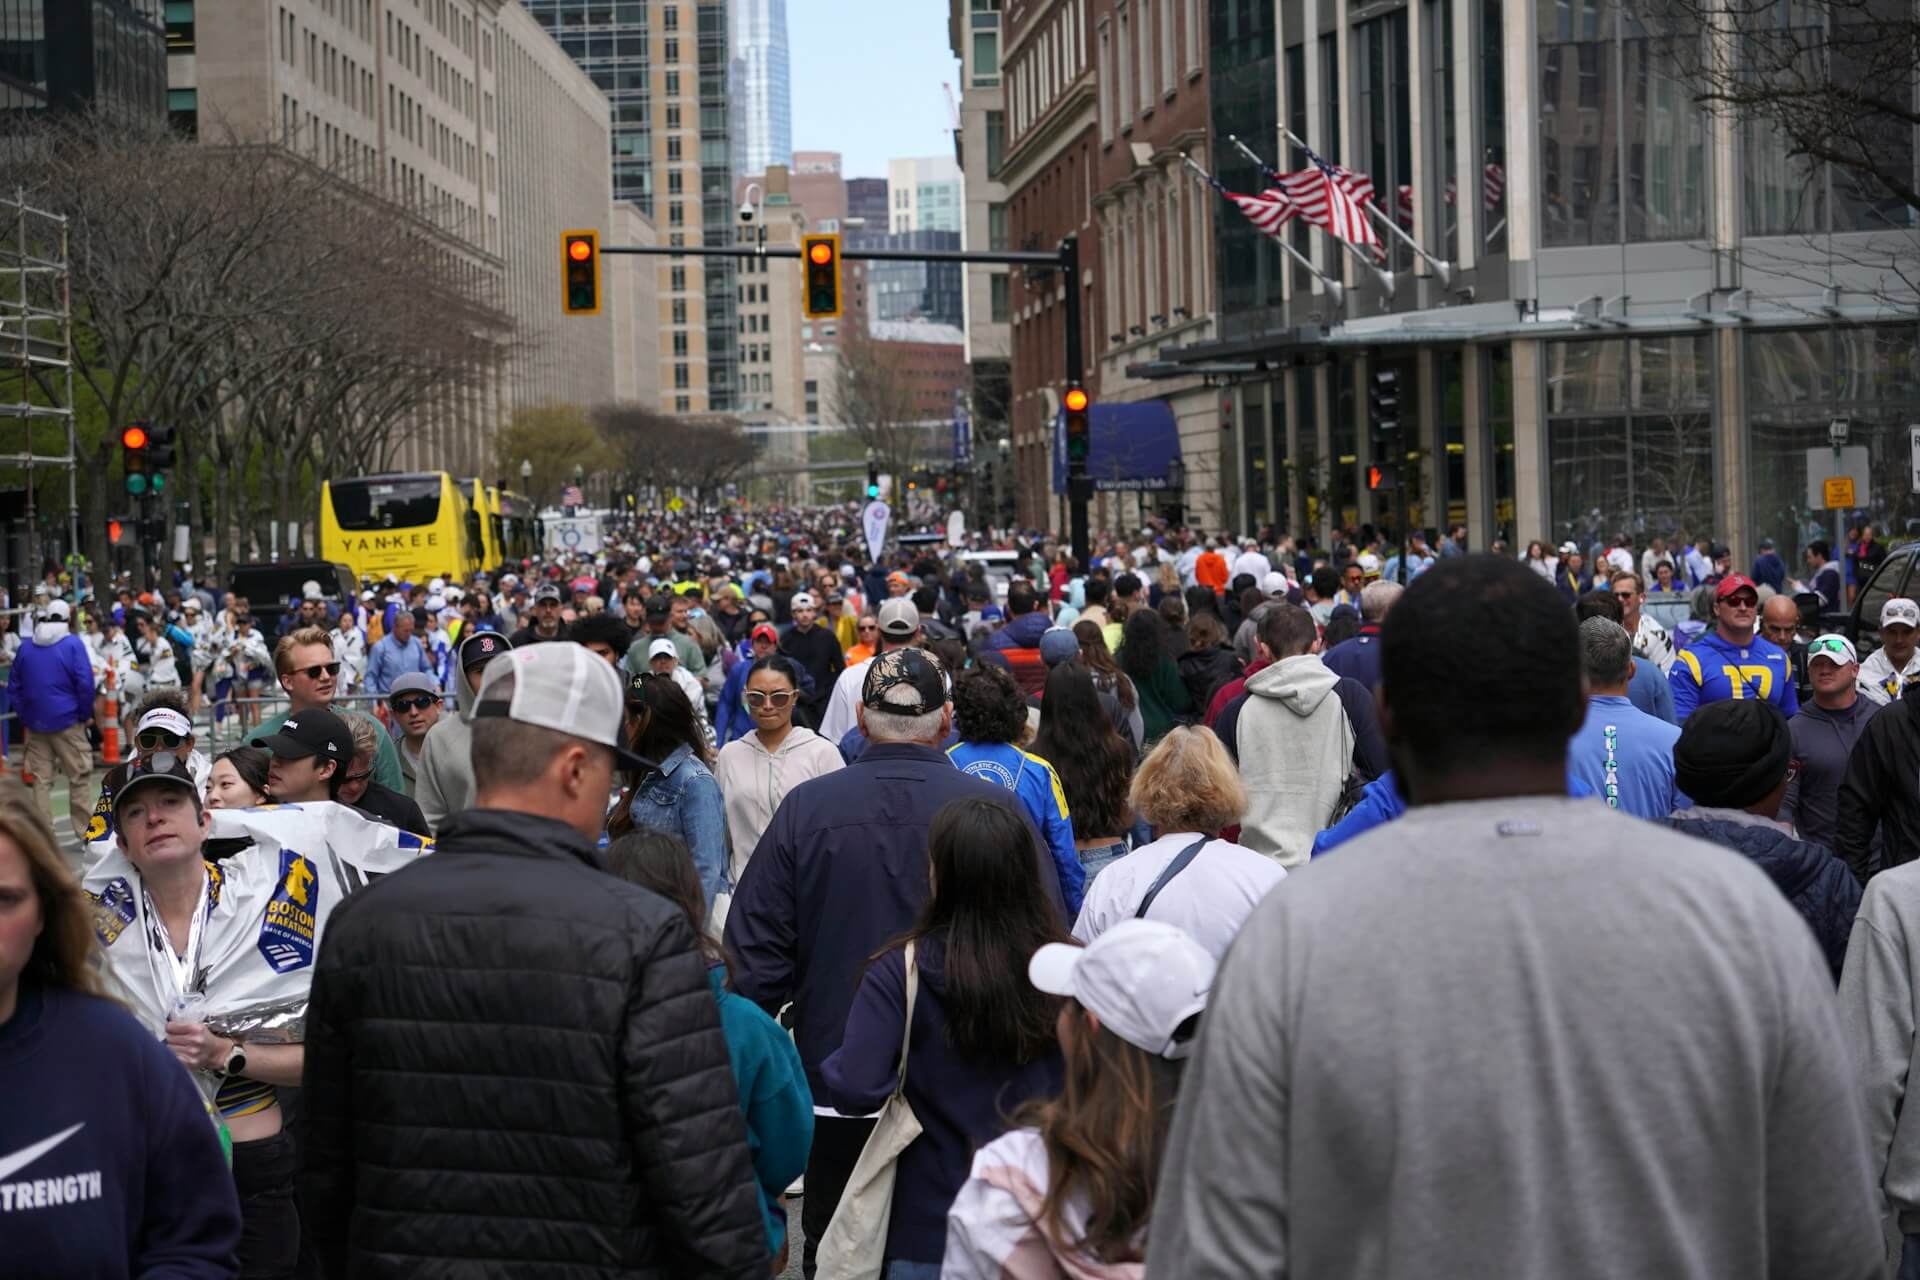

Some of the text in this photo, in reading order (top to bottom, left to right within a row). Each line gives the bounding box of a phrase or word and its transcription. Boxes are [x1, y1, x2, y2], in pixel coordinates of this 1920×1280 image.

[1096, 477, 1167, 491] University Club
[342, 533, 438, 552] YANKEE
[1722, 664, 1773, 700] 17
[1604, 725, 1619, 808] CHICAGO
[266, 914, 313, 939] MARATHON
[268, 901, 314, 928] BOSTON
[0, 1170, 102, 1212] TRENGTH
